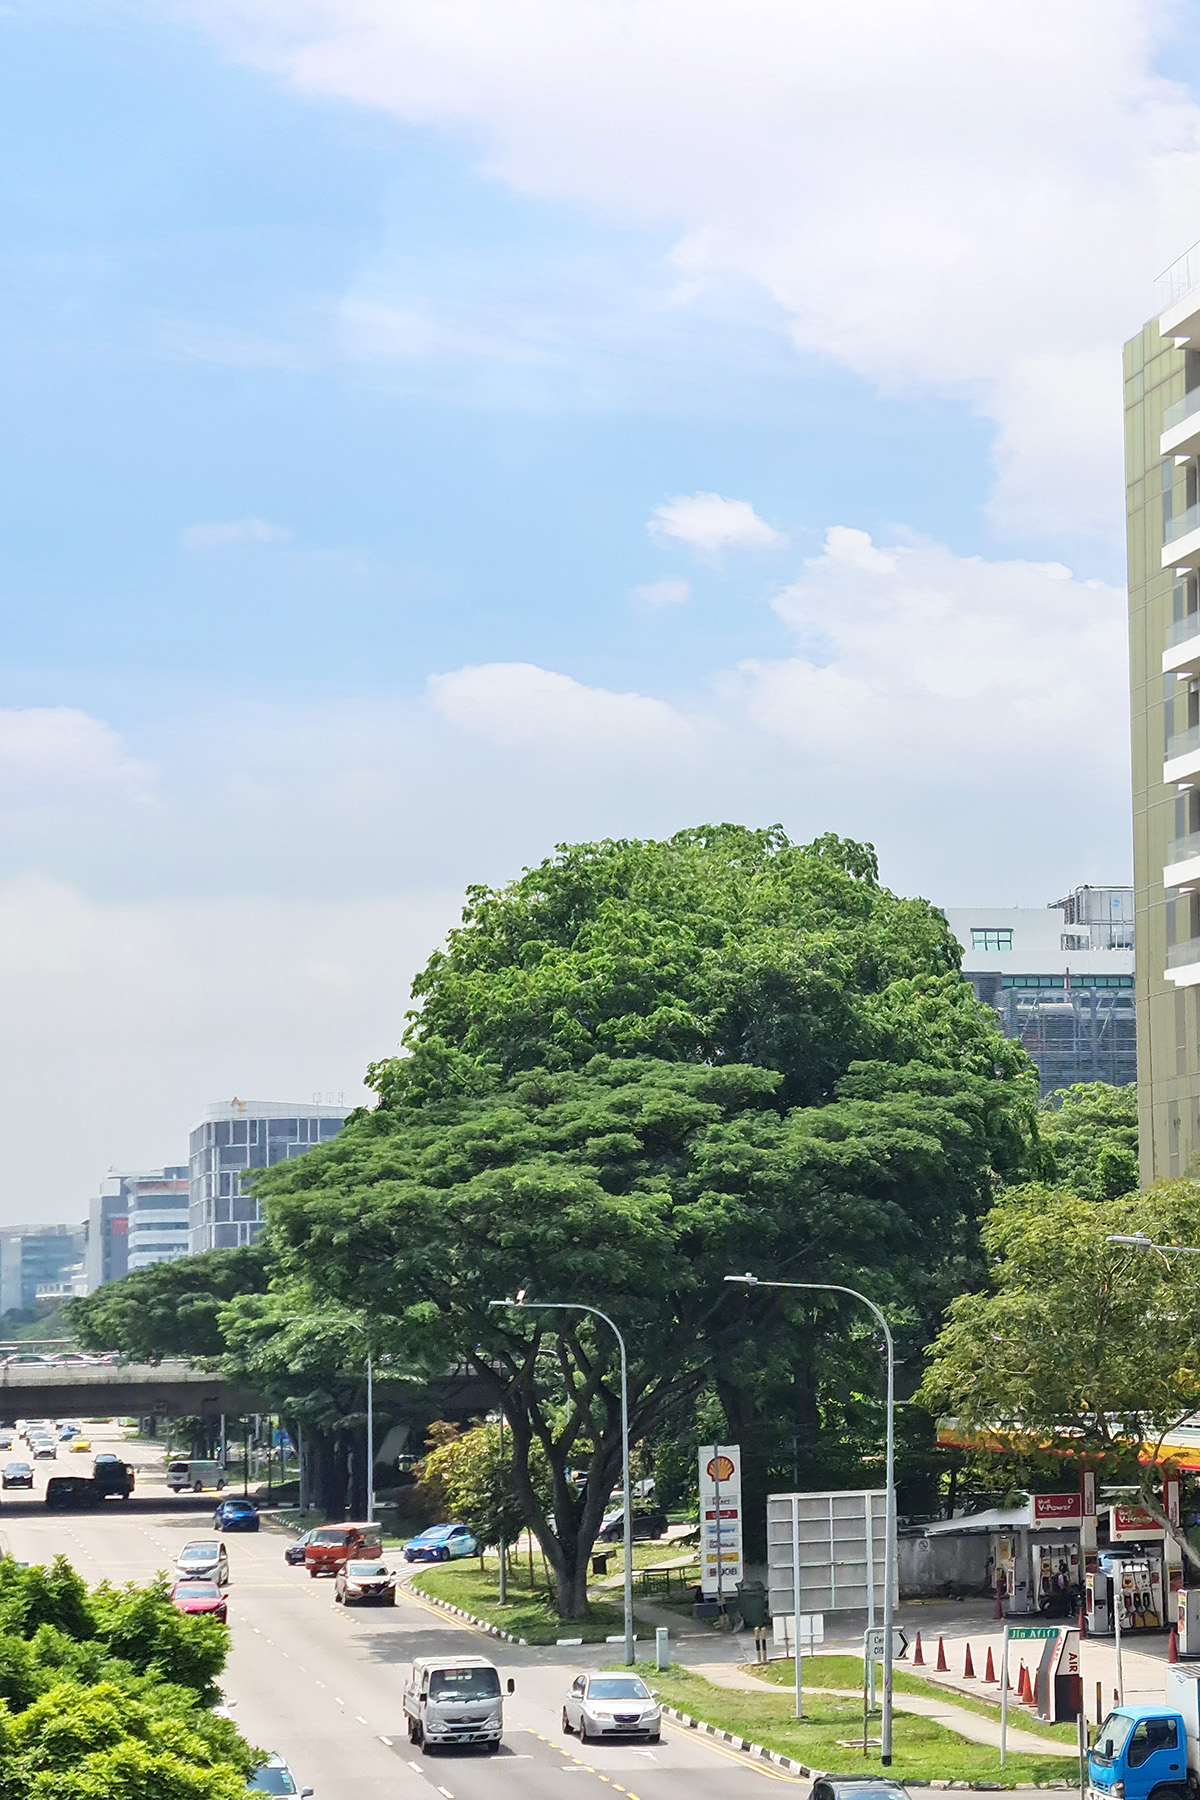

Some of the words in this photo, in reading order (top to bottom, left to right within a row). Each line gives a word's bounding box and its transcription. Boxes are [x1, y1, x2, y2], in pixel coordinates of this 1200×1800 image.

[1011, 1630, 1026, 1639] Jln
[1029, 1630, 1056, 1639] Afifi
[1068, 1652, 1078, 1673] AIR
